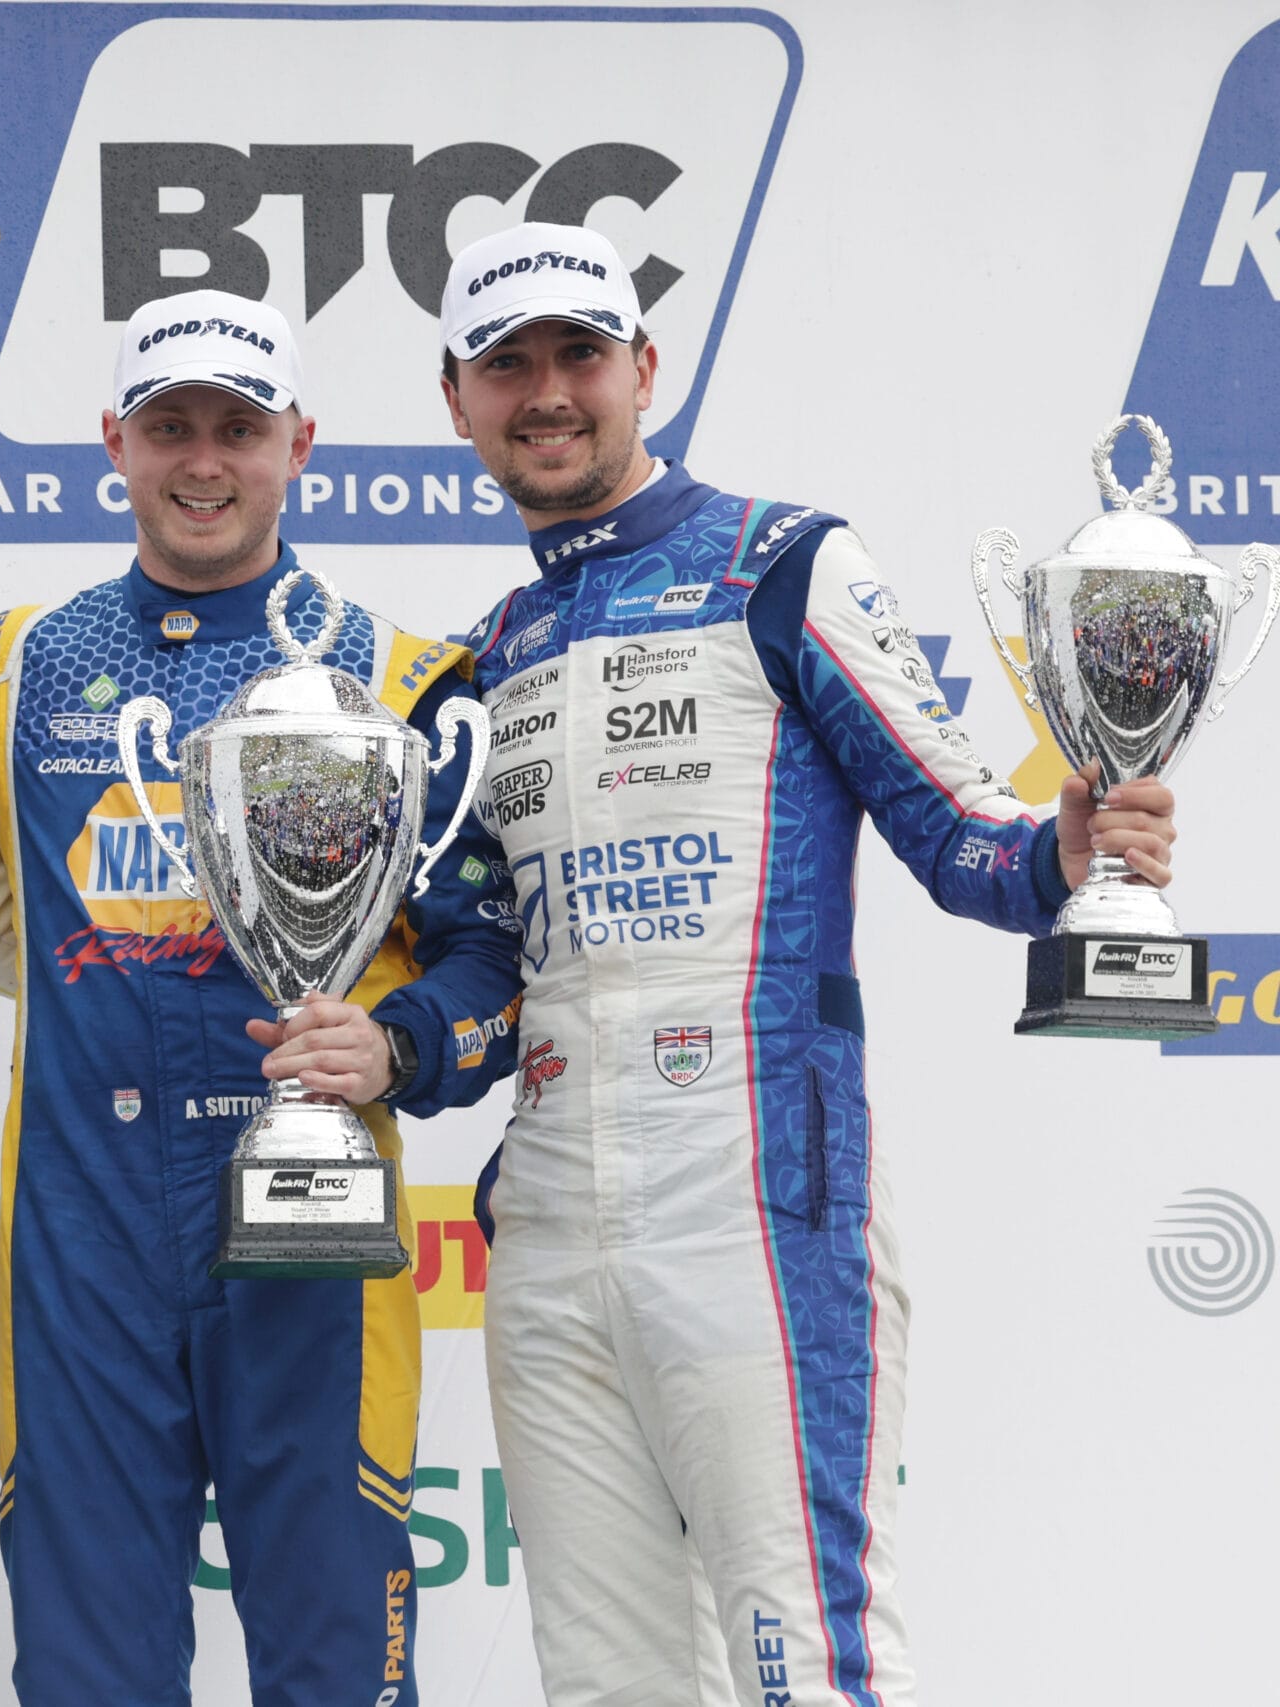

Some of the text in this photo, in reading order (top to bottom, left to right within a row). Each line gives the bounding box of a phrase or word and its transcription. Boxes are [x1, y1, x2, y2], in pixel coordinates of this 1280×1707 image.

[100, 142, 683, 322] BTCC
[468, 252, 607, 296] GOODYEAR
[138, 318, 276, 355] GOODYEAR
[1144, 475, 1280, 515] BRIT
[544, 521, 618, 565] HRX
[663, 590, 703, 603] BTCC
[166, 615, 195, 633] NAPA
[522, 622, 553, 646] STREET
[522, 635, 549, 656] MOTORS
[627, 646, 696, 666] Hansford
[400, 641, 455, 691] HRX
[627, 661, 688, 678] Sensors
[504, 689, 540, 710] MOTORS
[507, 669, 559, 701] MACKLIN
[50, 729, 118, 740] NEEDHA
[606, 698, 697, 742] S2M
[497, 743, 520, 756] FREIGHT
[606, 739, 697, 755] DISCOVERING PROFIT
[492, 767, 544, 802] DRAPER
[598, 763, 711, 793] EXCELR8
[96, 822, 197, 893] NAP
[561, 832, 732, 884] BRISTOL
[567, 872, 718, 923] STREET
[54, 911, 226, 984] Racing
[570, 913, 706, 956] MOTORS
[1141, 953, 1176, 965] BTCC
[671, 1071, 694, 1082] BRDC
[185, 1098, 203, 1120] A.
[315, 1178, 349, 1189] BTCC
[384, 1570, 411, 1681] PARTS
[753, 1609, 793, 1707] REET
